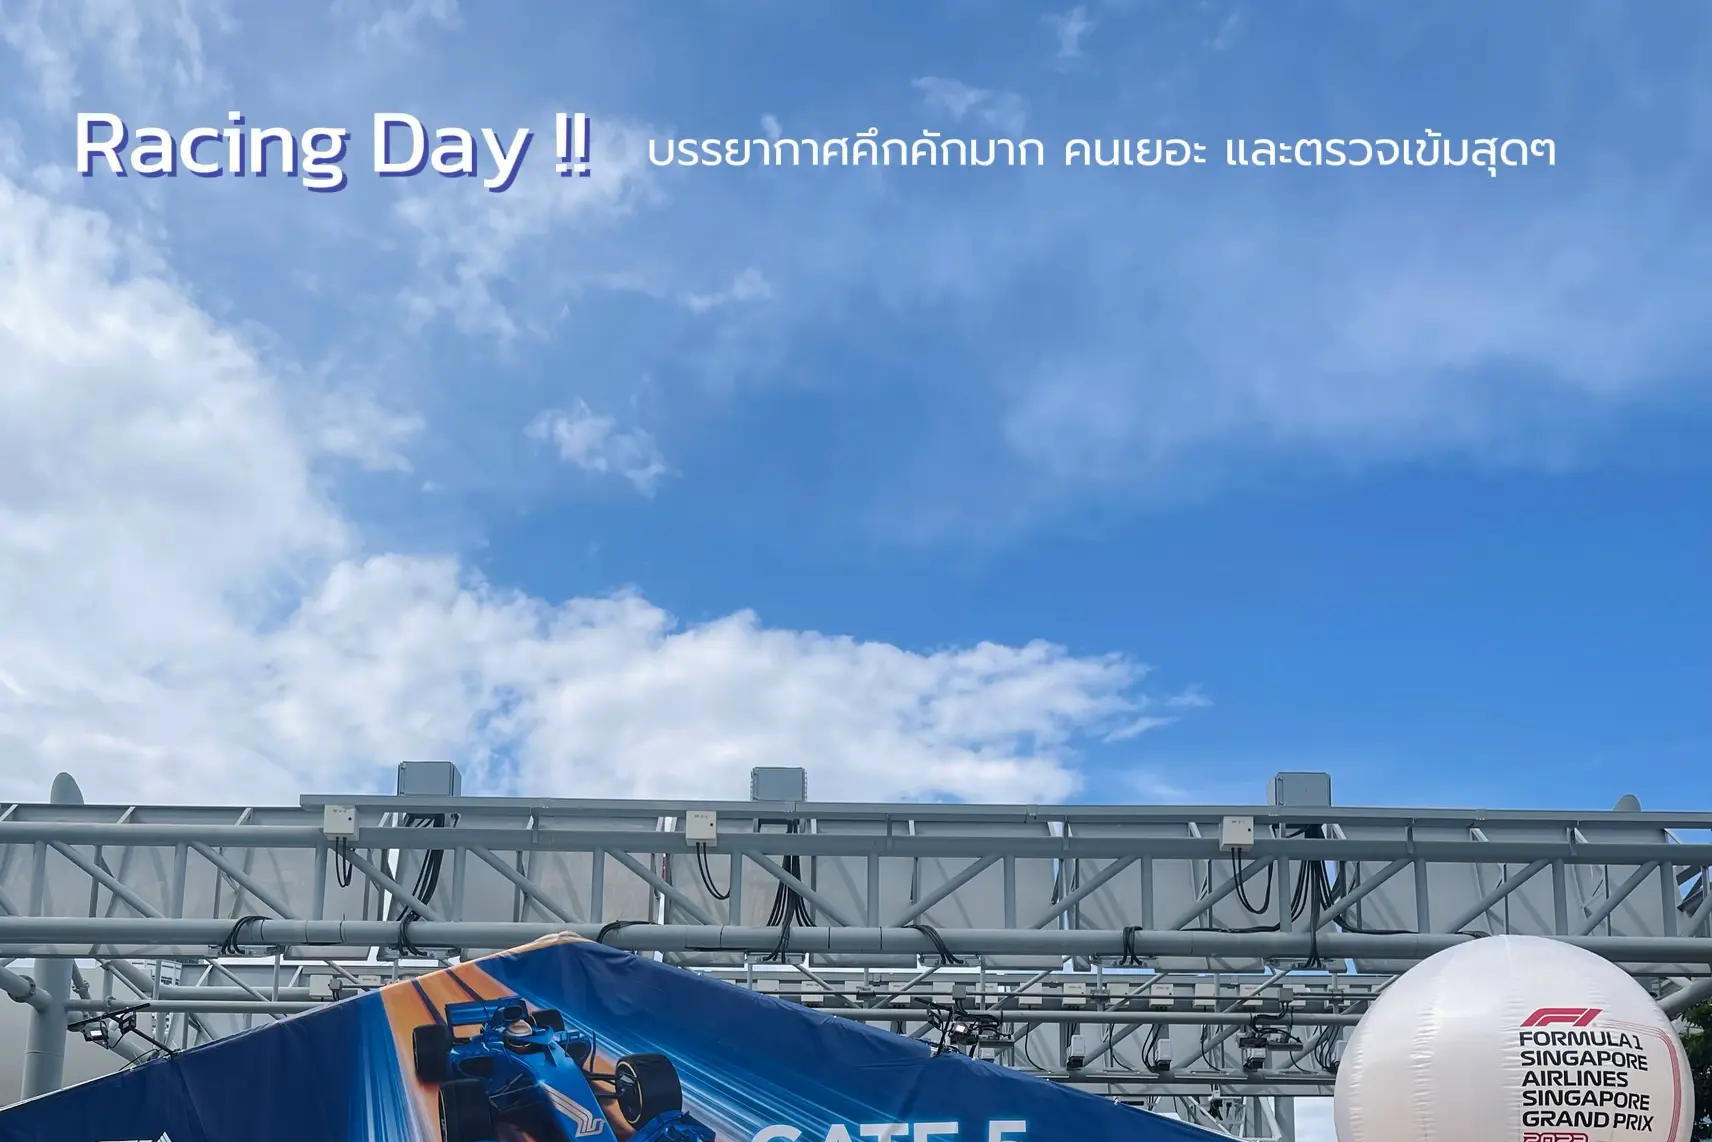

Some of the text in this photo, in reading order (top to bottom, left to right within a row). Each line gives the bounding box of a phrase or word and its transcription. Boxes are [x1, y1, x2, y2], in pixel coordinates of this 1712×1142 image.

[1519, 1030, 1643, 1051] FORMULA 1
[1520, 1050, 1649, 1072] SINGAPORE
[1521, 1070, 1629, 1088] AIRLINES
[1522, 1090, 1651, 1111] SINGAPORE
[1522, 1110, 1654, 1132] GRAND PRIX
